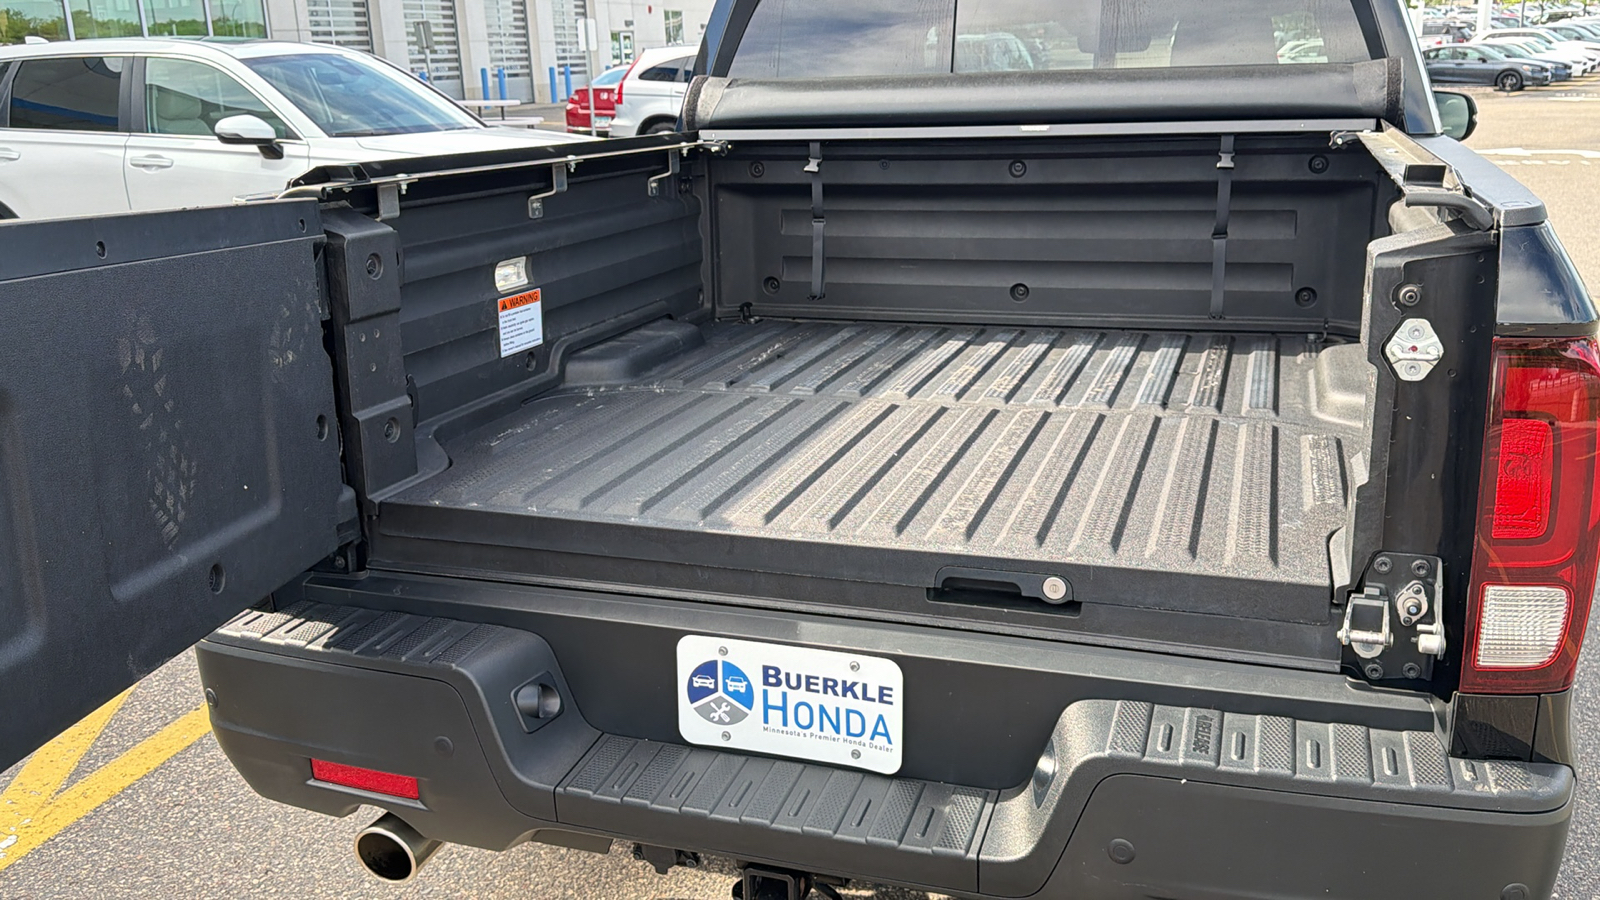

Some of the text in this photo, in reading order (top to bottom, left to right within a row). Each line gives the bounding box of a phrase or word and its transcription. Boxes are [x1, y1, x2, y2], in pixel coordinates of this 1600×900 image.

[509, 292, 538, 307] WARNING
[762, 665, 894, 705] BUERKLE
[763, 689, 893, 745] HONDA
[763, 726, 893, 753] Minnesota's Premier Honda Dealer
[1193, 721, 1212, 755] RELEASE
